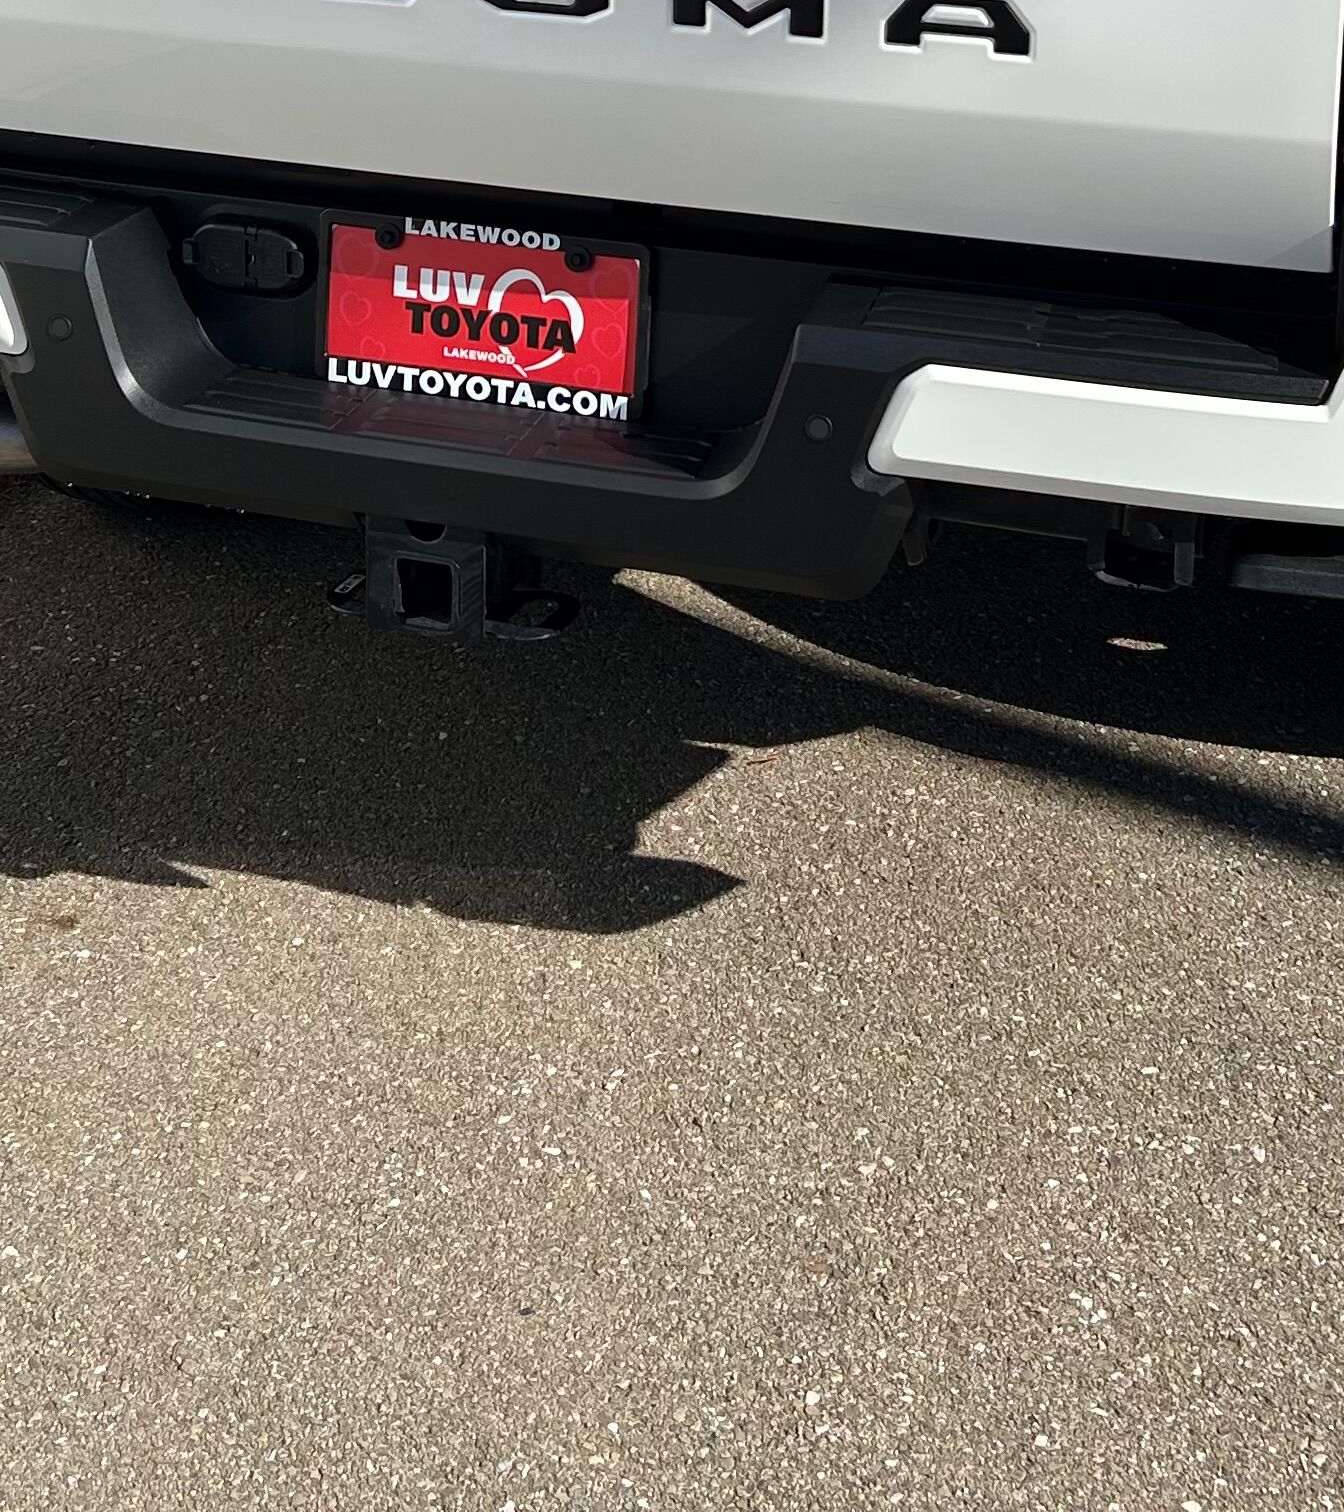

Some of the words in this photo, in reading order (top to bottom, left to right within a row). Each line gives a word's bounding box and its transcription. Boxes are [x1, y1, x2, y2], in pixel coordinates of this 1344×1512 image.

[404, 216, 561, 252] LAKEWOOD
[392, 264, 485, 307] LUV
[405, 302, 577, 354] TOYOTA
[442, 345, 517, 366] LAKEWOOD
[327, 356, 630, 422] LUVTOYOTA.COM
